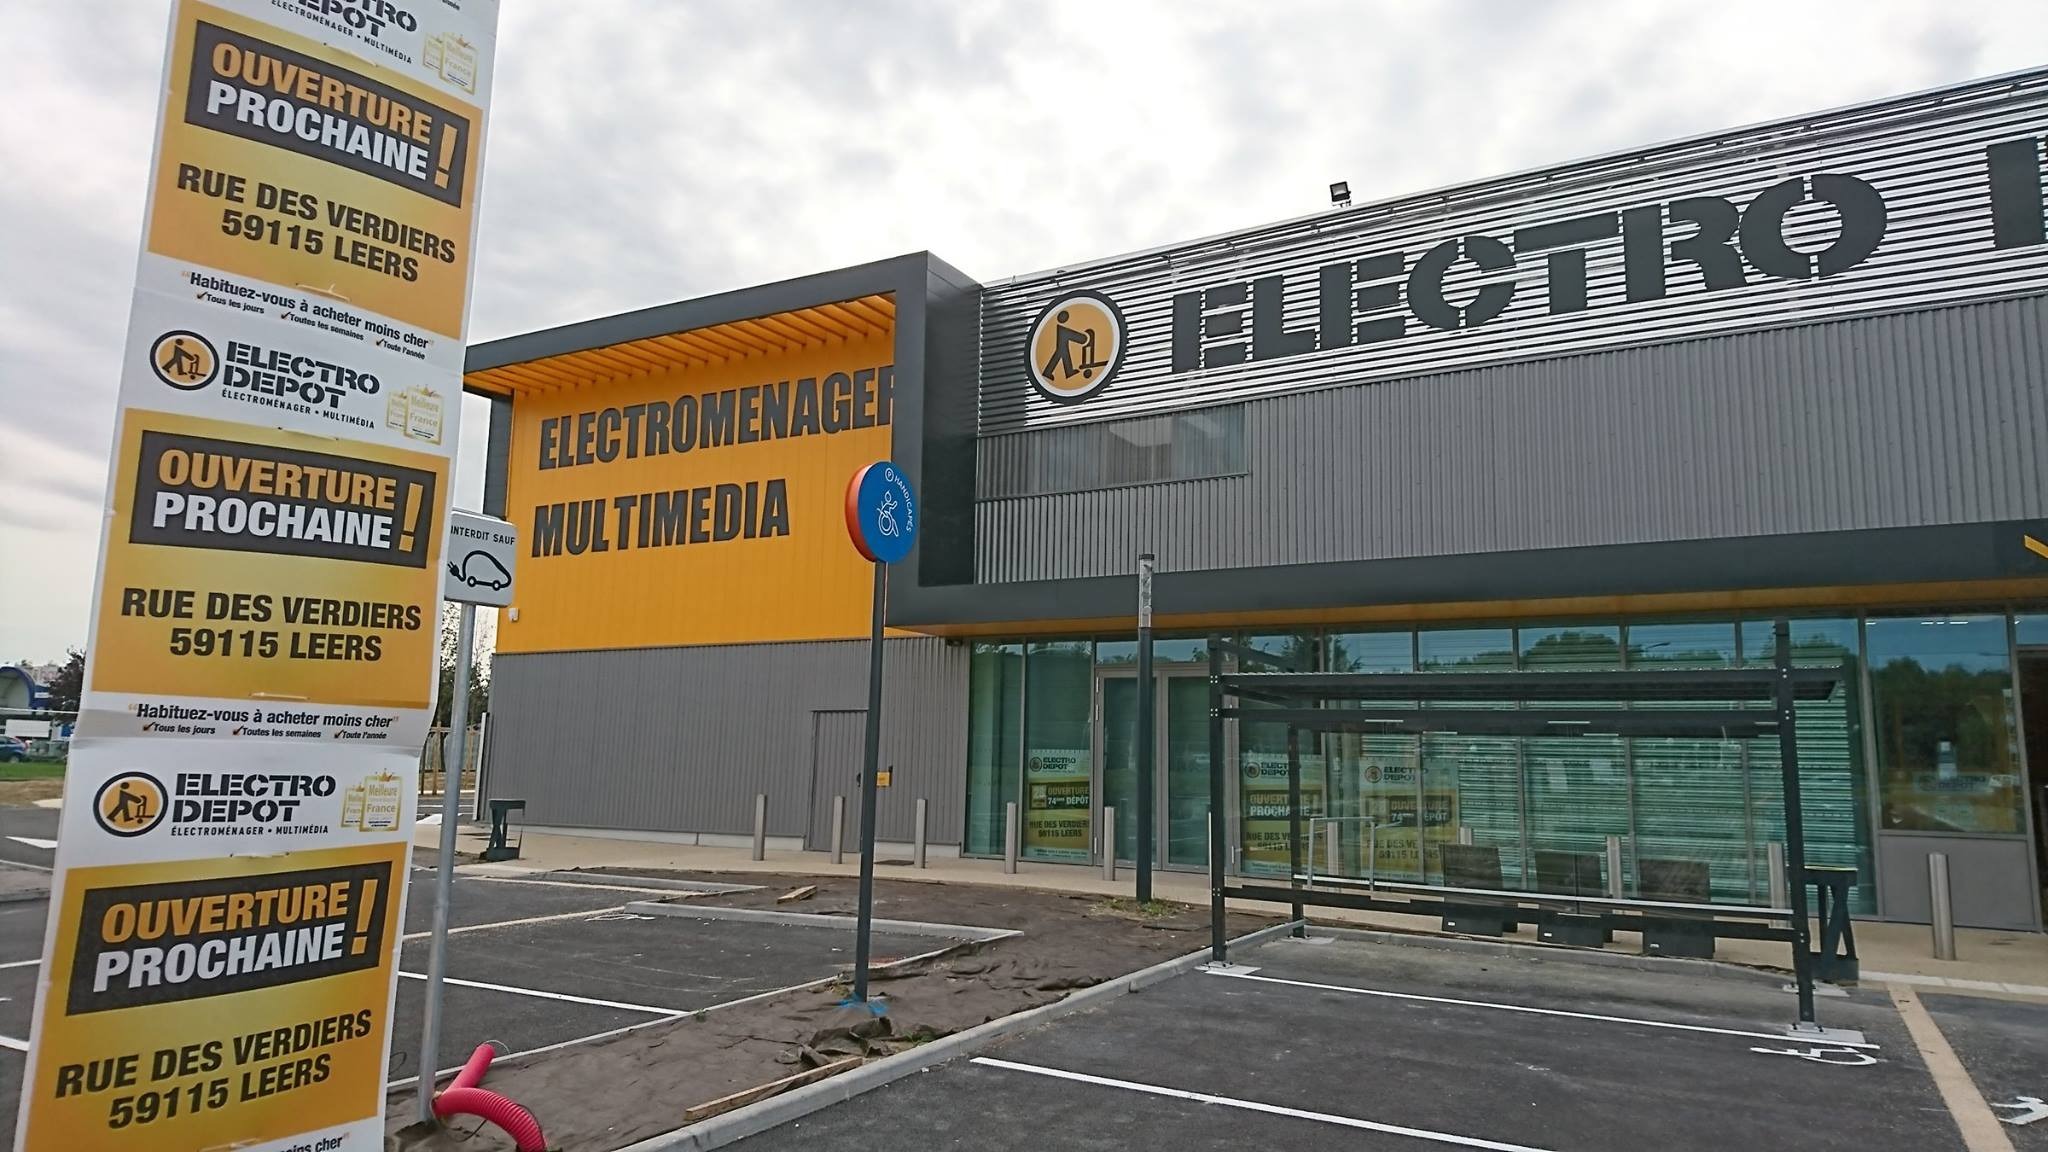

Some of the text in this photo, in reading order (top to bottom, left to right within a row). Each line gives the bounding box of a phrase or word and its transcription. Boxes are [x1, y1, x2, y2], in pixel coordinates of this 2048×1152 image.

[212, 43, 432, 145] OUVERTURE
[207, 80, 428, 181] PROCHAINE
[177, 163, 456, 264] RUE DES VERDIERS
[221, 209, 419, 283] 59115 LEERS
[1171, 172, 1888, 374] ELECTRO
[206, 293, 265, 314] Tous les jours
[300, 299, 309, 312] à
[313, 305, 362, 327] acheter
[364, 320, 400, 340] moins
[290, 313, 315, 327] Toutes
[331, 325, 364, 341] semaines
[384, 340, 401, 353] Toute
[223, 365, 346, 409] DEPOT
[226, 341, 380, 394] ELECTRO
[222, 389, 375, 429] ÉLECTROMÉNAGER MULTIMÉDIA
[158, 449, 397, 511] OUVERTURE
[153, 491, 393, 549] PROCHAINE
[450, 525, 516, 545] INTERDIT SAUF
[531, 478, 791, 558] MULTIMEDIA
[121, 587, 422, 631] RUE DES VERDIERS
[170, 628, 382, 661] 59115 LEERS
[153, 723, 216, 736] Tous les jours
[242, 727, 321, 739] Toutes les semaines
[253, 709, 263, 723] à
[267, 711, 320, 725] acheter
[323, 713, 362, 727] moins
[342, 730, 361, 739] Toute
[175, 773, 336, 797] ELECTRO
[1261, 769, 1288, 777] DEPO
[171, 824, 329, 836] ÉLECTROMÉNAGER MULTIMÉDIA
[172, 799, 300, 822] DEPOT
[1044, 820, 1057, 829] DES
[102, 881, 350, 944] OUVERTURE
[93, 922, 345, 993] PROCHAINE
[55, 1008, 372, 1099] RUE DES VERDIERS
[108, 1053, 331, 1130] 59115 LEERS
